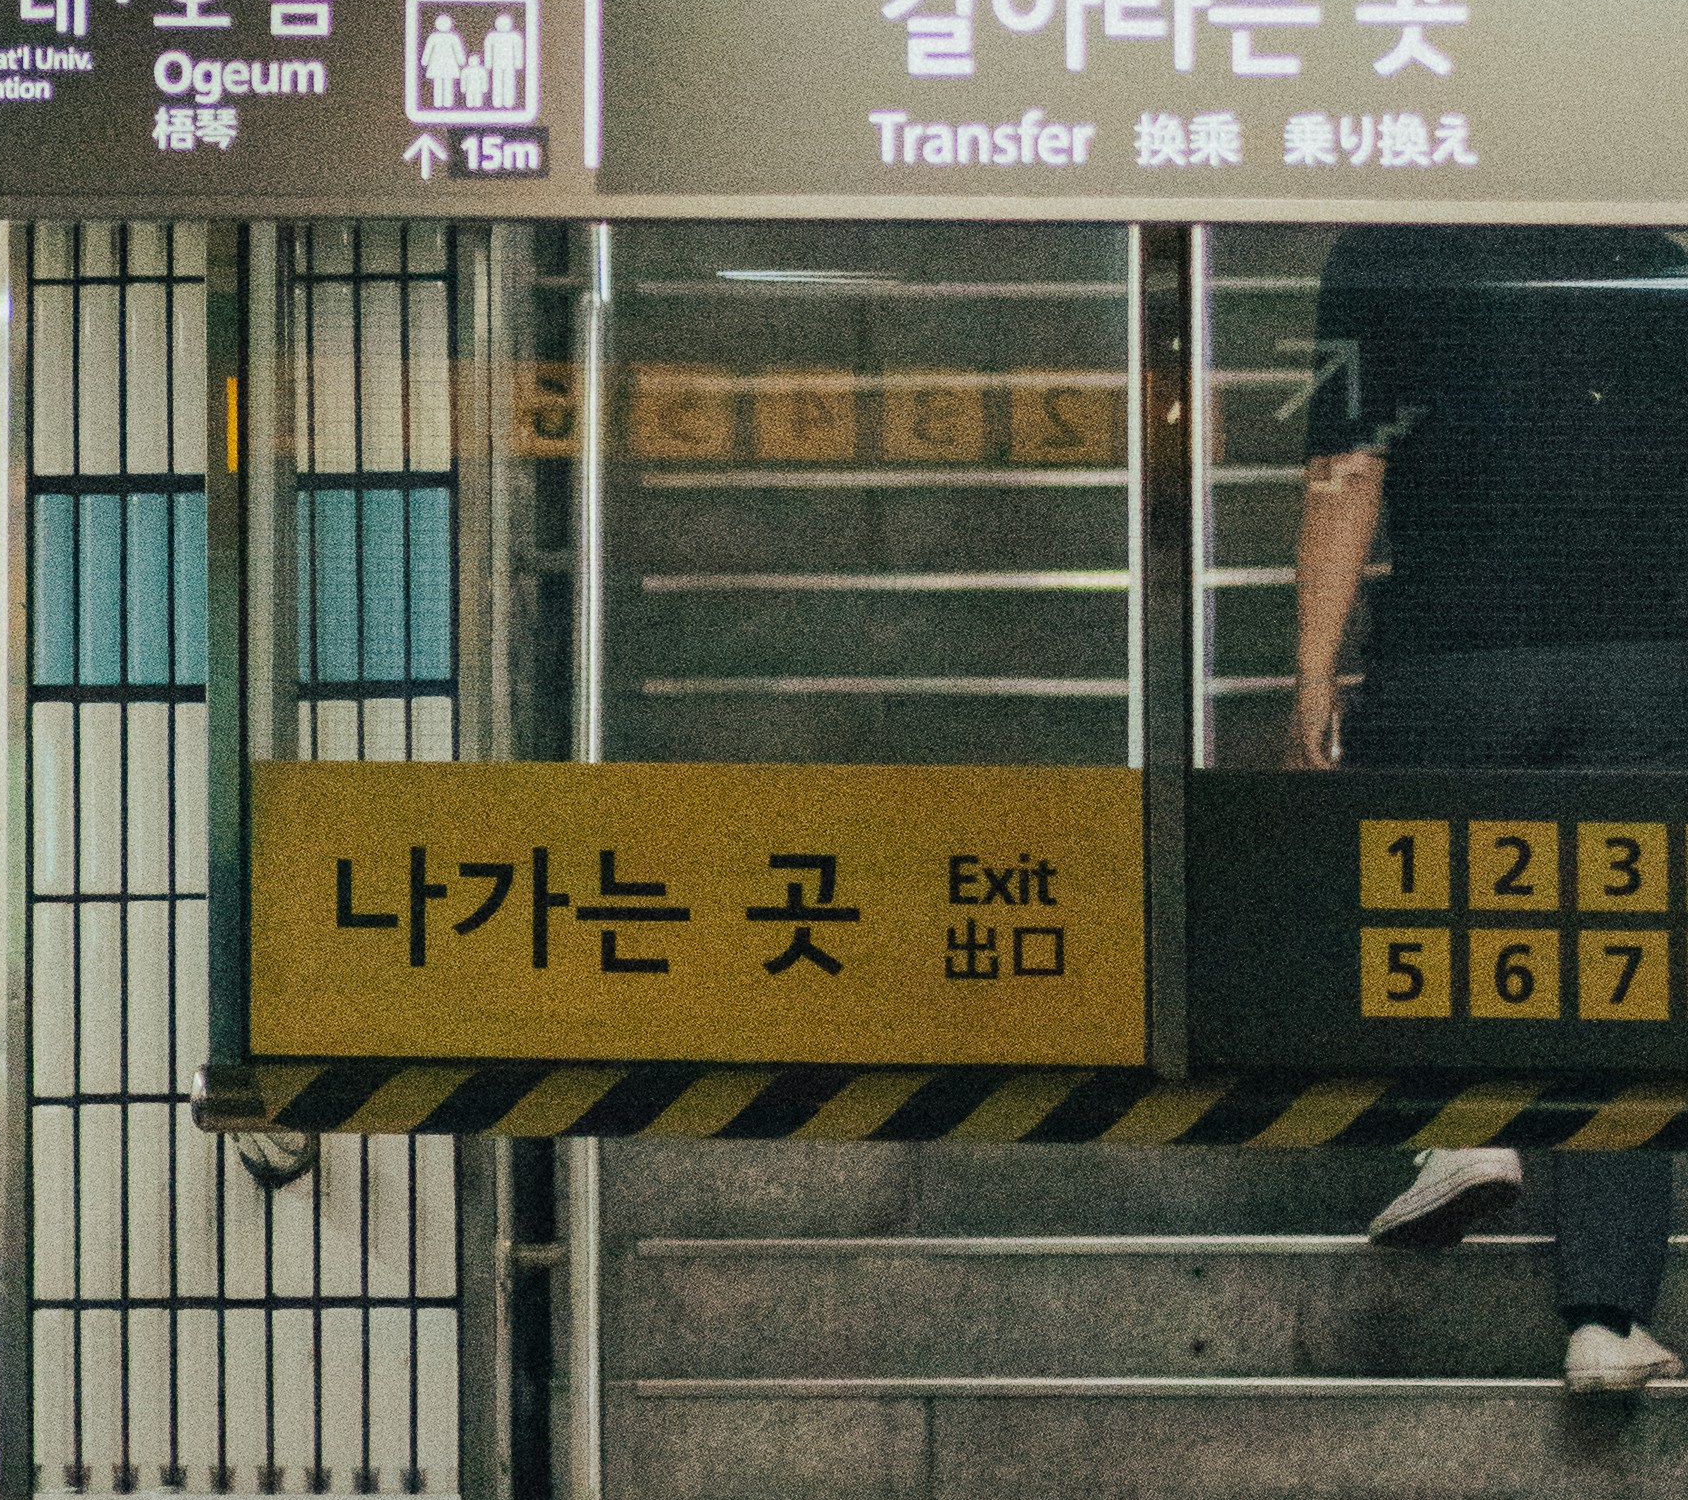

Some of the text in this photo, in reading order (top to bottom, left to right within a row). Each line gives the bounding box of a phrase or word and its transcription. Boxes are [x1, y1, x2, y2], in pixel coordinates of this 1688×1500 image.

[34, 46, 94, 71] Univ.
[153, 50, 327, 104] Ogeum
[152, 106, 238, 151] 梧琴
[460, 134, 541, 171] 15m
[868, 107, 1096, 166] Transfer
[1283, 112, 1479, 167] 乗り換え
[948, 853, 1058, 906] Exit
[1387, 836, 1642, 897] 1 2 3
[336, 845, 862, 977] 나가는 곳
[944, 917, 1066, 981] 出口
[1386, 942, 1644, 1005] 5 6 7
